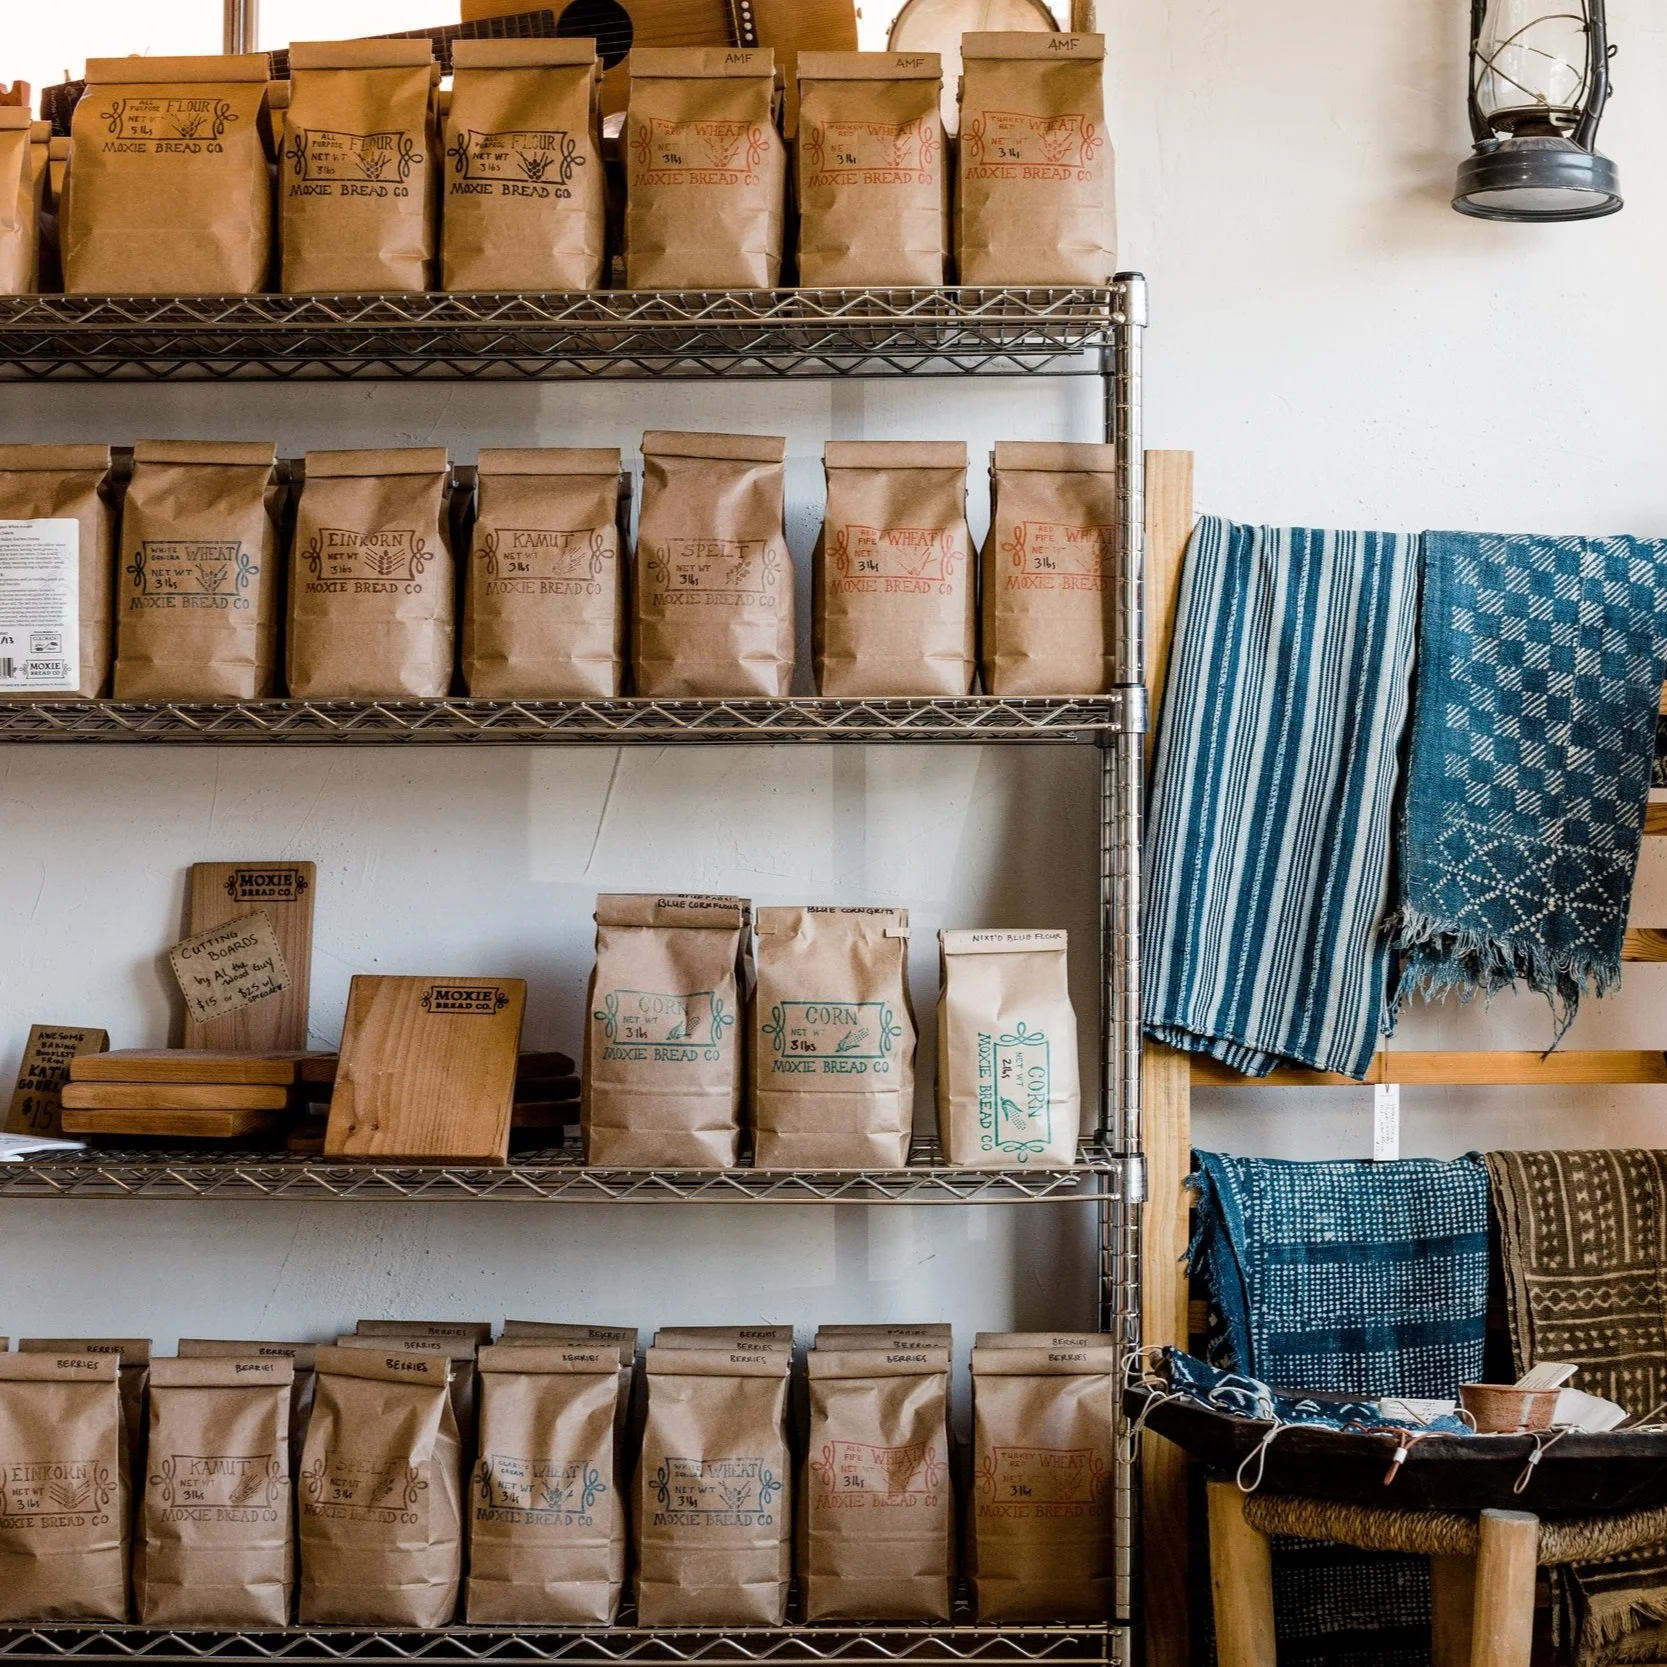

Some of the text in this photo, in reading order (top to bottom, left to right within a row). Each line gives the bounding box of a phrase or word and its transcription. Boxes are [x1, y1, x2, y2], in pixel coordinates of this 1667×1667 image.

[1048, 38, 1080, 51] AMF
[724, 53, 754, 64] AMF
[895, 58, 925, 69] AMF
[166, 100, 210, 113] FLOUR
[694, 124, 745, 137] WHEAT
[867, 124, 913, 137] WHEAT
[1029, 119, 1078, 132] WHEAT
[102, 142, 224, 154] MOXIE BREAD CO
[349, 136, 394, 152] FLOUR
[511, 134, 556, 151] FLOUR
[472, 152, 510, 161] NET WT
[633, 172, 760, 187] MOXIE BREAD CO
[808, 172, 933, 188] MOXIE BREAD CO
[965, 167, 1093, 181] MOXIE BREAD CO
[289, 184, 409, 198] MOXIE BREAD CO
[450, 182, 572, 199] MOXIE BREAD CO
[328, 533, 404, 547] EINKORN
[513, 533, 575, 548] KAMUT
[887, 531, 938, 546] WHEAT
[184, 546, 236, 561] WHEAT
[328, 553, 344, 561] NET
[681, 543, 750, 559] SPELT
[152, 569, 171, 577] NET
[305, 582, 422, 595] MOXIE BREAD CO
[485, 582, 602, 596] MOXIE BREAD CO
[830, 580, 953, 595] MOXIE BREAD CO
[1006, 575, 1108, 591] MOXIE BREAD
[129, 597, 250, 610] MOXIE BREAD CO
[651, 593, 775, 607] MOXIE BREAD CO
[30, 662, 61, 670] MOXIE
[240, 875, 293, 887] MOXIE
[241, 888, 275, 896] BREAD
[657, 898, 686, 908] BLUE
[688, 901, 712, 909] CORN
[807, 906, 836, 914] BLUE
[1006, 934, 1032, 943] BLUE
[1034, 932, 1062, 940] FLOUR
[182, 930, 238, 959] CUTTING
[207, 933, 259, 961] BOARDS
[252, 957, 275, 973] Guy
[194, 976, 211, 988] by
[214, 968, 229, 981] Al
[196, 996, 217, 1012] $15
[238, 983, 260, 999] $25
[434, 990, 493, 1001] MOXIE
[645, 1016, 658, 1024] WT
[805, 1006, 858, 1025] CORN
[39, 1032, 85, 1042] AWESOME
[41, 1041, 77, 1050] BAKING
[602, 1048, 720, 1061] MOXIE BREAD CO
[772, 1060, 890, 1073] MOXIE BREAD CO
[978, 1032, 993, 1151] MOXIE BREAD CO
[1027, 1065, 1047, 1119] CORN
[404, 1341, 441, 1350] BERRIES
[730, 1355, 767, 1364] BERRIES
[887, 1355, 927, 1364] BERRIES
[1048, 1353, 1087, 1362] BERRIES
[57, 1360, 99, 1370] BERRIES
[235, 1364, 274, 1373] BERRIES
[386, 1358, 428, 1373] BERRIES
[871, 1448, 925, 1464] WHEAT
[1039, 1455, 1087, 1468] WHEAT
[12, 1465, 87, 1482] EINKORN
[190, 1460, 251, 1476] KAMUT
[533, 1464, 580, 1479] WHEAT
[708, 1464, 757, 1478] WHEAT
[180, 1479, 201, 1487] NET
[497, 1481, 536, 1493] NET WT
[12, 1488, 45, 1496] NET WT
[674, 1486, 694, 1494] NET
[815, 1494, 938, 1509] MOXIE BREAD CO
[160, 1509, 278, 1523] MOXIE BREAD CO
[477, 1508, 592, 1526] MOXIE BREAD CO
[653, 1513, 773, 1526] MOXIE BREAD CO
